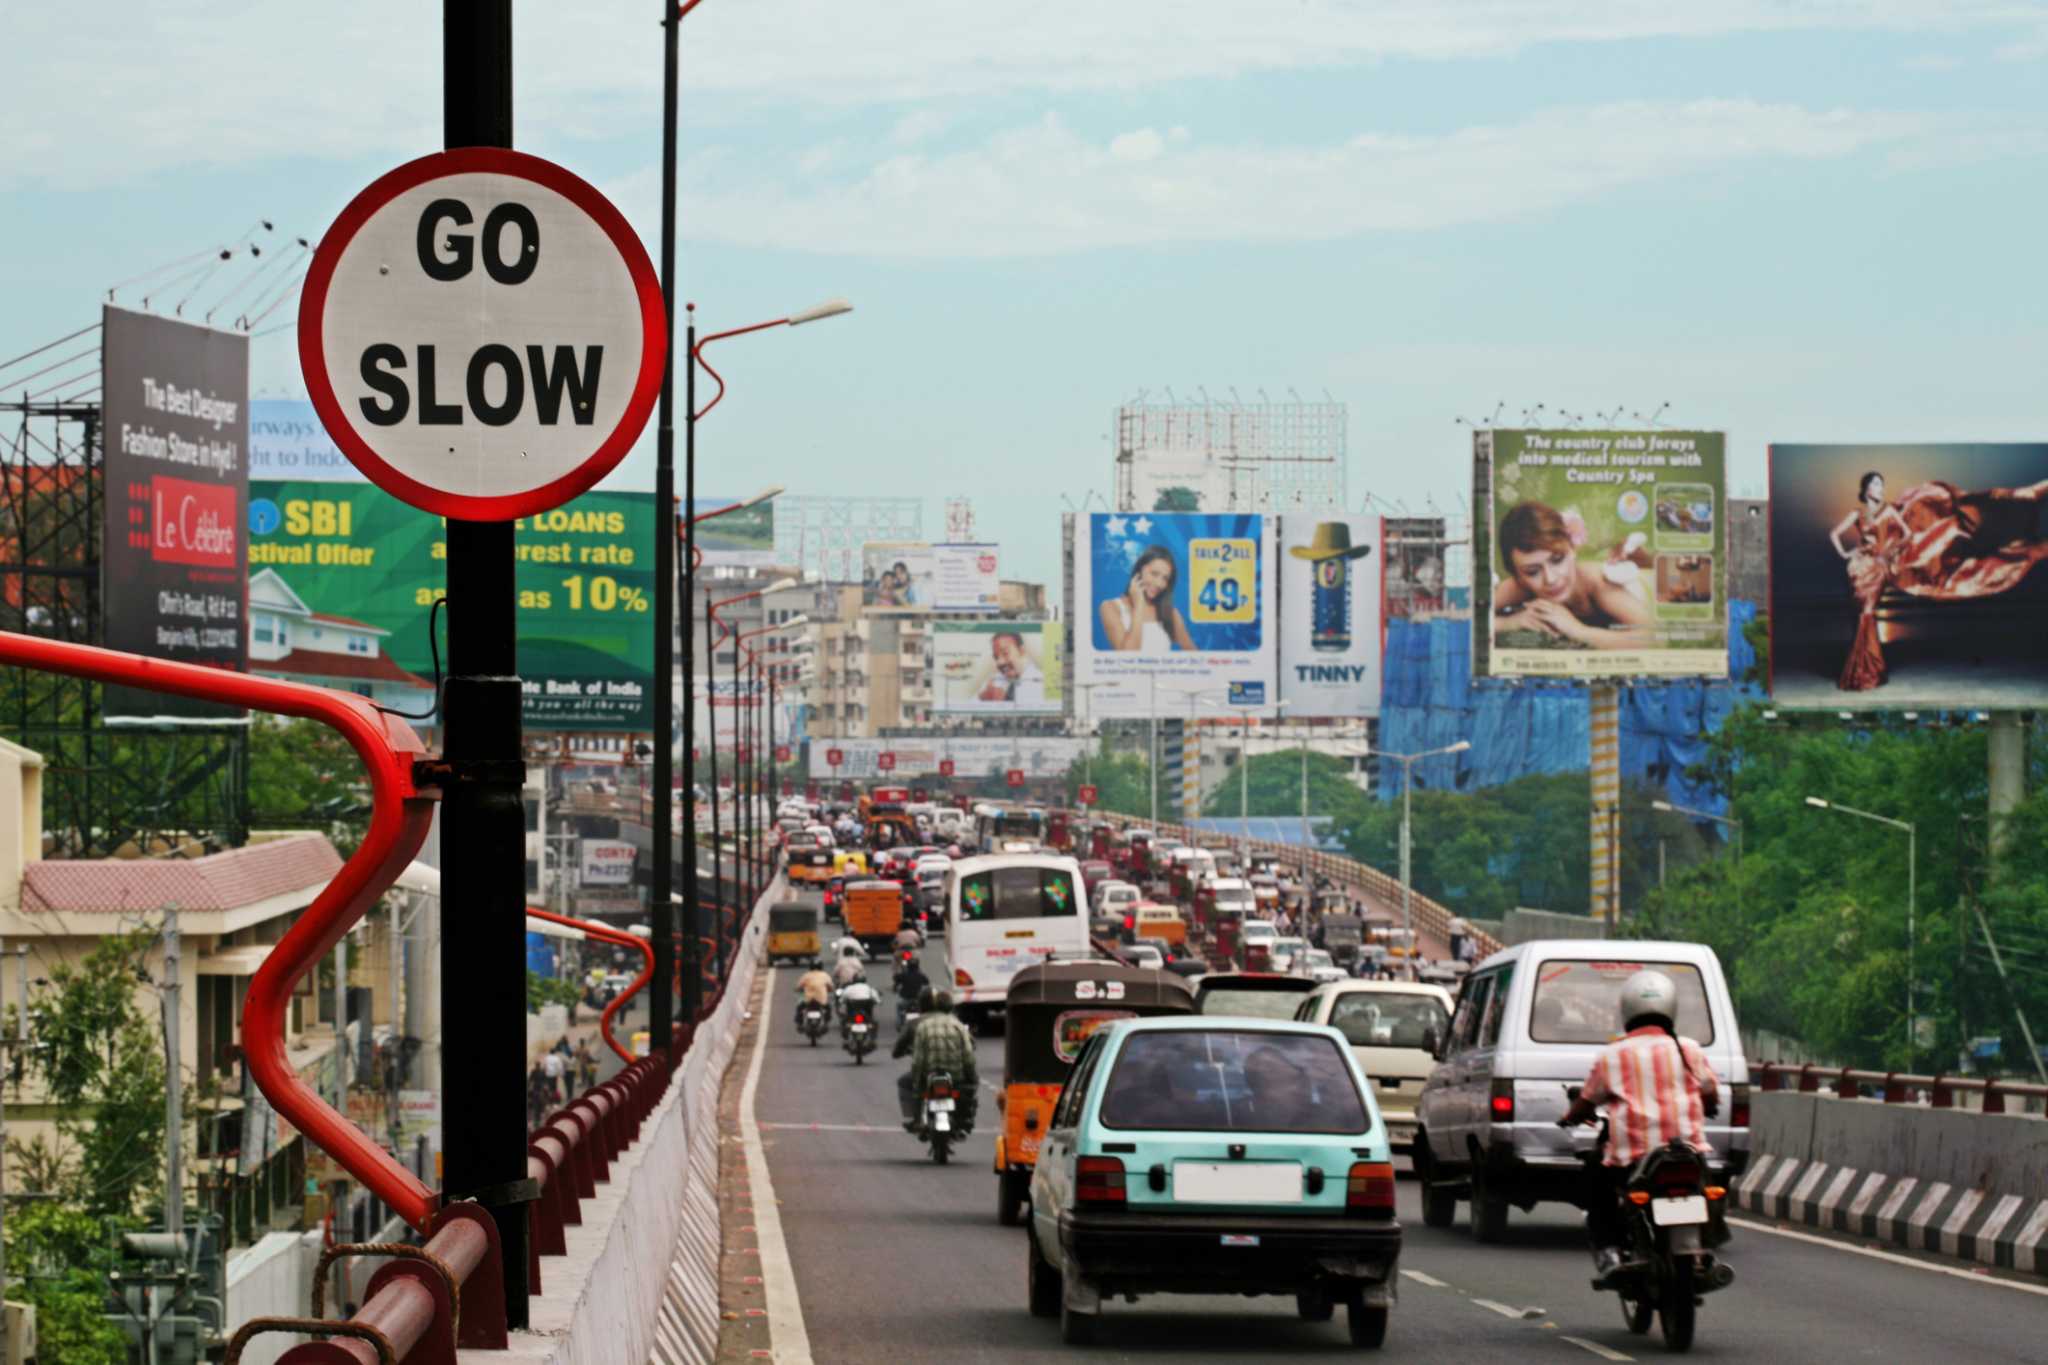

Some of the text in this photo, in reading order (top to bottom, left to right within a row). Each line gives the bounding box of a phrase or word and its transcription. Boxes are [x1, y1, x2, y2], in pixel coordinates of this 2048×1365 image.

[416, 198, 540, 285] GO
[359, 343, 604, 427] SLOW
[142, 377, 238, 431] The Best Designer
[122, 423, 168, 460] Fashion
[168, 431, 198, 467] Store
[1524, 434, 1696, 453] The country club forays
[1517, 451, 1702, 467] into medical tourism with
[1565, 469, 1656, 484] Country Spa
[156, 491, 177, 549] Le
[285, 500, 352, 536] SBI
[533, 510, 625, 534] LOANS
[316, 543, 374, 566] Offer
[580, 544, 635, 565] rate
[519, 590, 552, 609] as
[562, 575, 648, 612] 10%
[1294, 663, 1366, 683] TINNY
[546, 679, 582, 695] Bank
[586, 680, 603, 694] of
[607, 681, 642, 696] India
